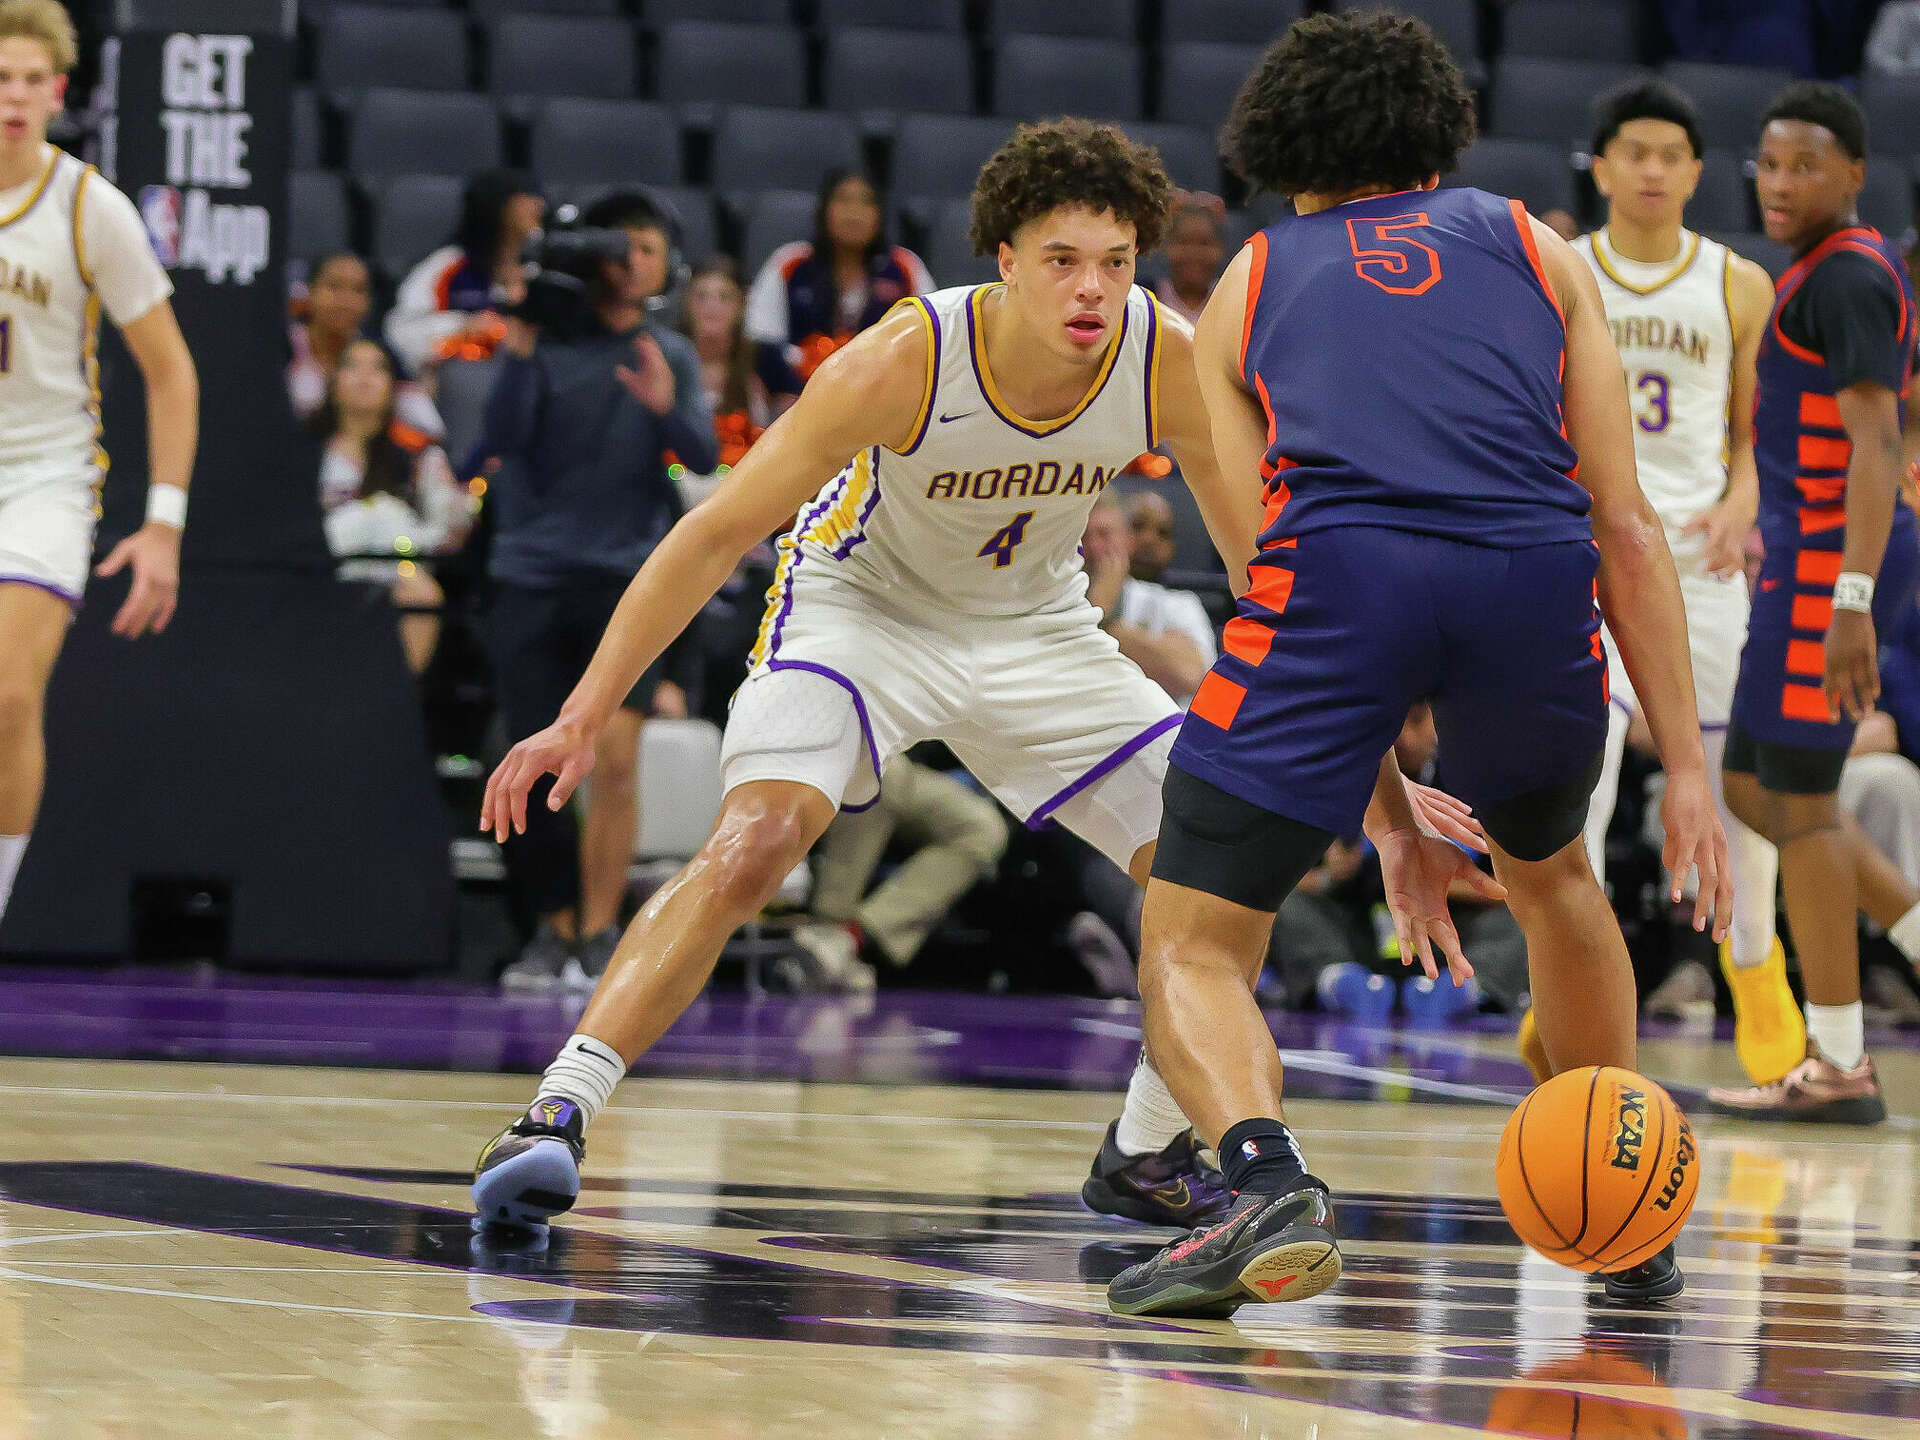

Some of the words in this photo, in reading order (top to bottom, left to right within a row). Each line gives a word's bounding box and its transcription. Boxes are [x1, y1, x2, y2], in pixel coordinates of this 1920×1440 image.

[163, 33, 253, 108] GET
[160, 111, 252, 189] THE
[181, 188, 270, 285] App
[1345, 212, 1443, 296] 5
[1637, 371, 1672, 434] 3
[926, 460, 1116, 500] RIORDAN
[976, 509, 1036, 570] 4
[1610, 1083, 1647, 1171] NCAA
